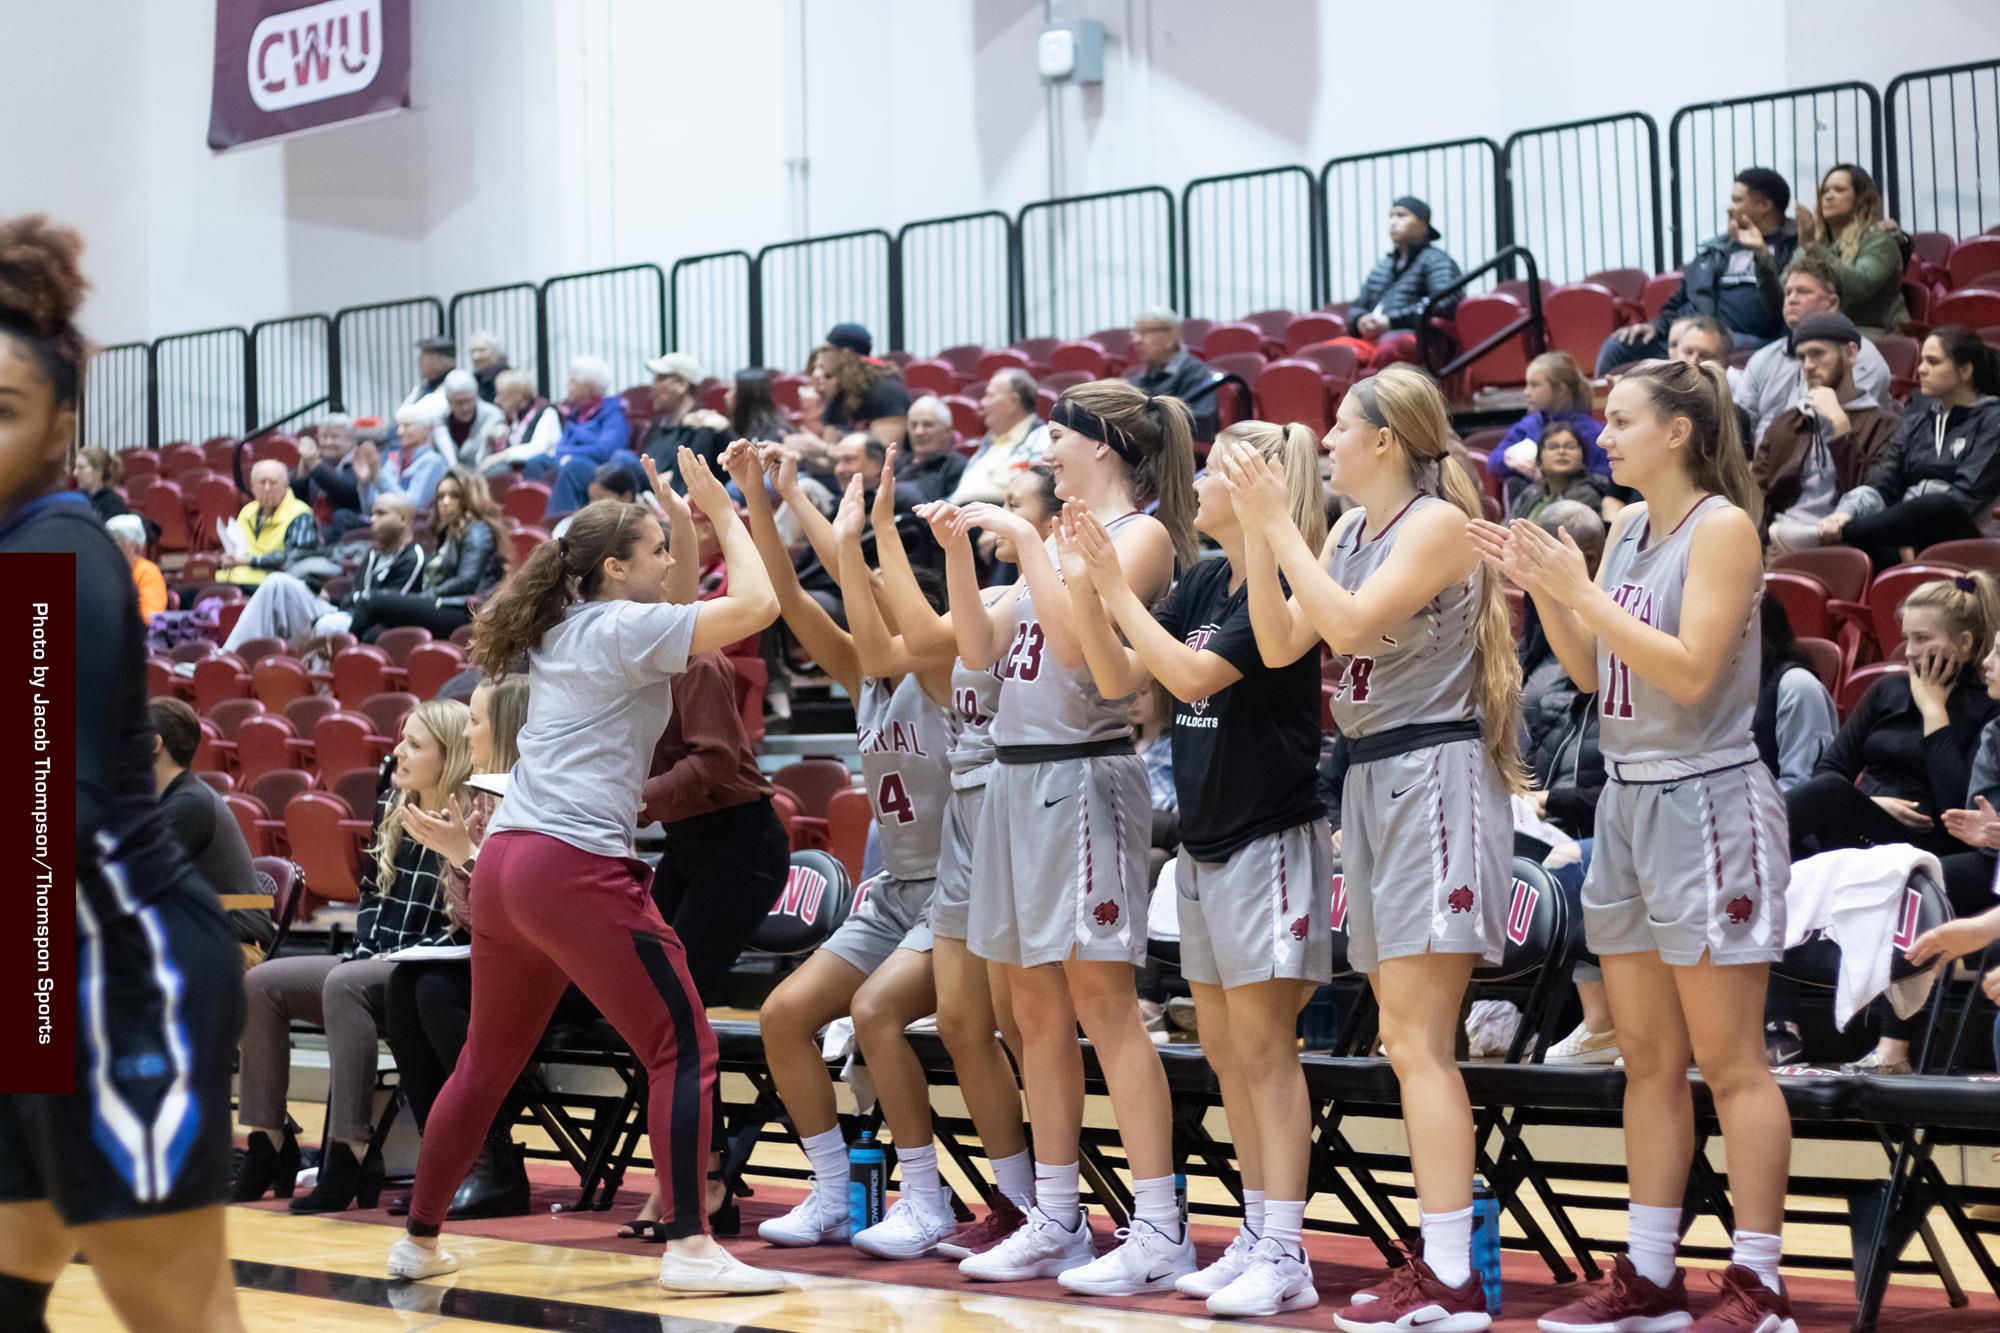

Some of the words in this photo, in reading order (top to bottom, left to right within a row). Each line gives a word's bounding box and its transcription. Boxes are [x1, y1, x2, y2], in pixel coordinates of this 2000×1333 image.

[257, 10, 370, 93] CWU
[1003, 620, 1045, 683] 23
[1603, 652, 1634, 720] 11
[876, 770, 917, 827] 4
[768, 865, 828, 926] WU
[870, 1168, 879, 1225] OWERADE
